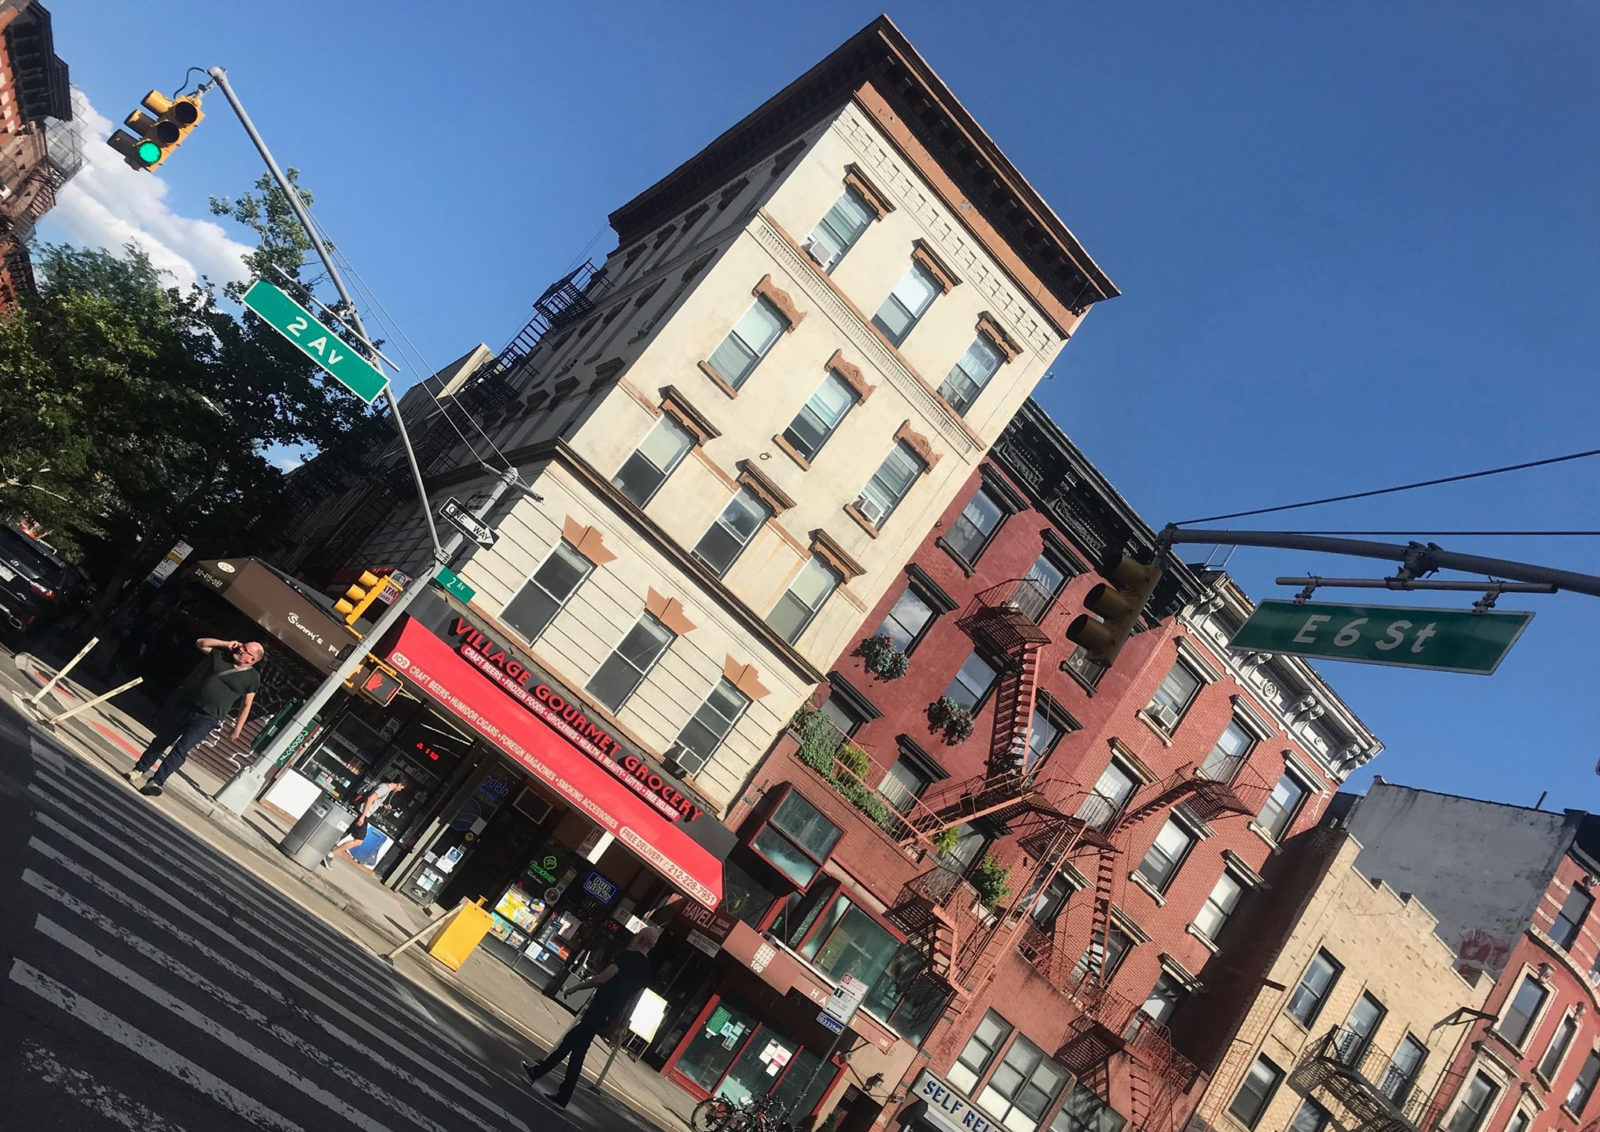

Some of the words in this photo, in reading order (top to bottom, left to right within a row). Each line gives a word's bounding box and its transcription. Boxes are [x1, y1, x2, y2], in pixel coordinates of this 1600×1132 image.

[286, 317, 309, 338] 2
[307, 336, 344, 366] Av
[446, 505, 467, 524] ONE
[472, 525, 491, 542] WAY
[446, 576, 456, 588] 2
[285, 612, 324, 645] Sunny's
[1292, 614, 1331, 643] E
[1333, 617, 1369, 647] 6
[1375, 620, 1438, 654] St
[454, 616, 532, 686] VILLAGE
[534, 683, 621, 758] GOURMET
[624, 754, 704, 823] GROCERY
[463, 646, 485, 665] CRAFT
[481, 661, 503, 681] BEERS
[503, 678, 527, 700] FROZEN
[524, 695, 545, 715] FOODS
[545, 711, 578, 740] GROCERIES
[577, 737, 600, 758] HEALTH
[602, 757, 624, 777] BEAUTY
[623, 774, 643, 791] LOTTO
[643, 789, 658, 803] FREE
[654, 798, 679, 819] DELIVERY
[392, 653, 408, 668] 102
[408, 665, 431, 685] CRAFT
[427, 679, 450, 699] BEERS
[448, 695, 479, 721] HUMIDOR
[475, 715, 500, 737] CIGARS
[498, 734, 525, 757] FOREIGN
[522, 752, 557, 781] MAGAZINES
[555, 778, 584, 802] SMOKING
[580, 797, 619, 829] ACCESSORIES
[620, 828, 638, 844] FREE
[635, 839, 664, 864] DELIVERY
[665, 863, 716, 905] 212-228-7951
[681, 900, 716, 929] HAVELI
[748, 960, 764, 974] 100
[923, 1080, 963, 1114] SELF
